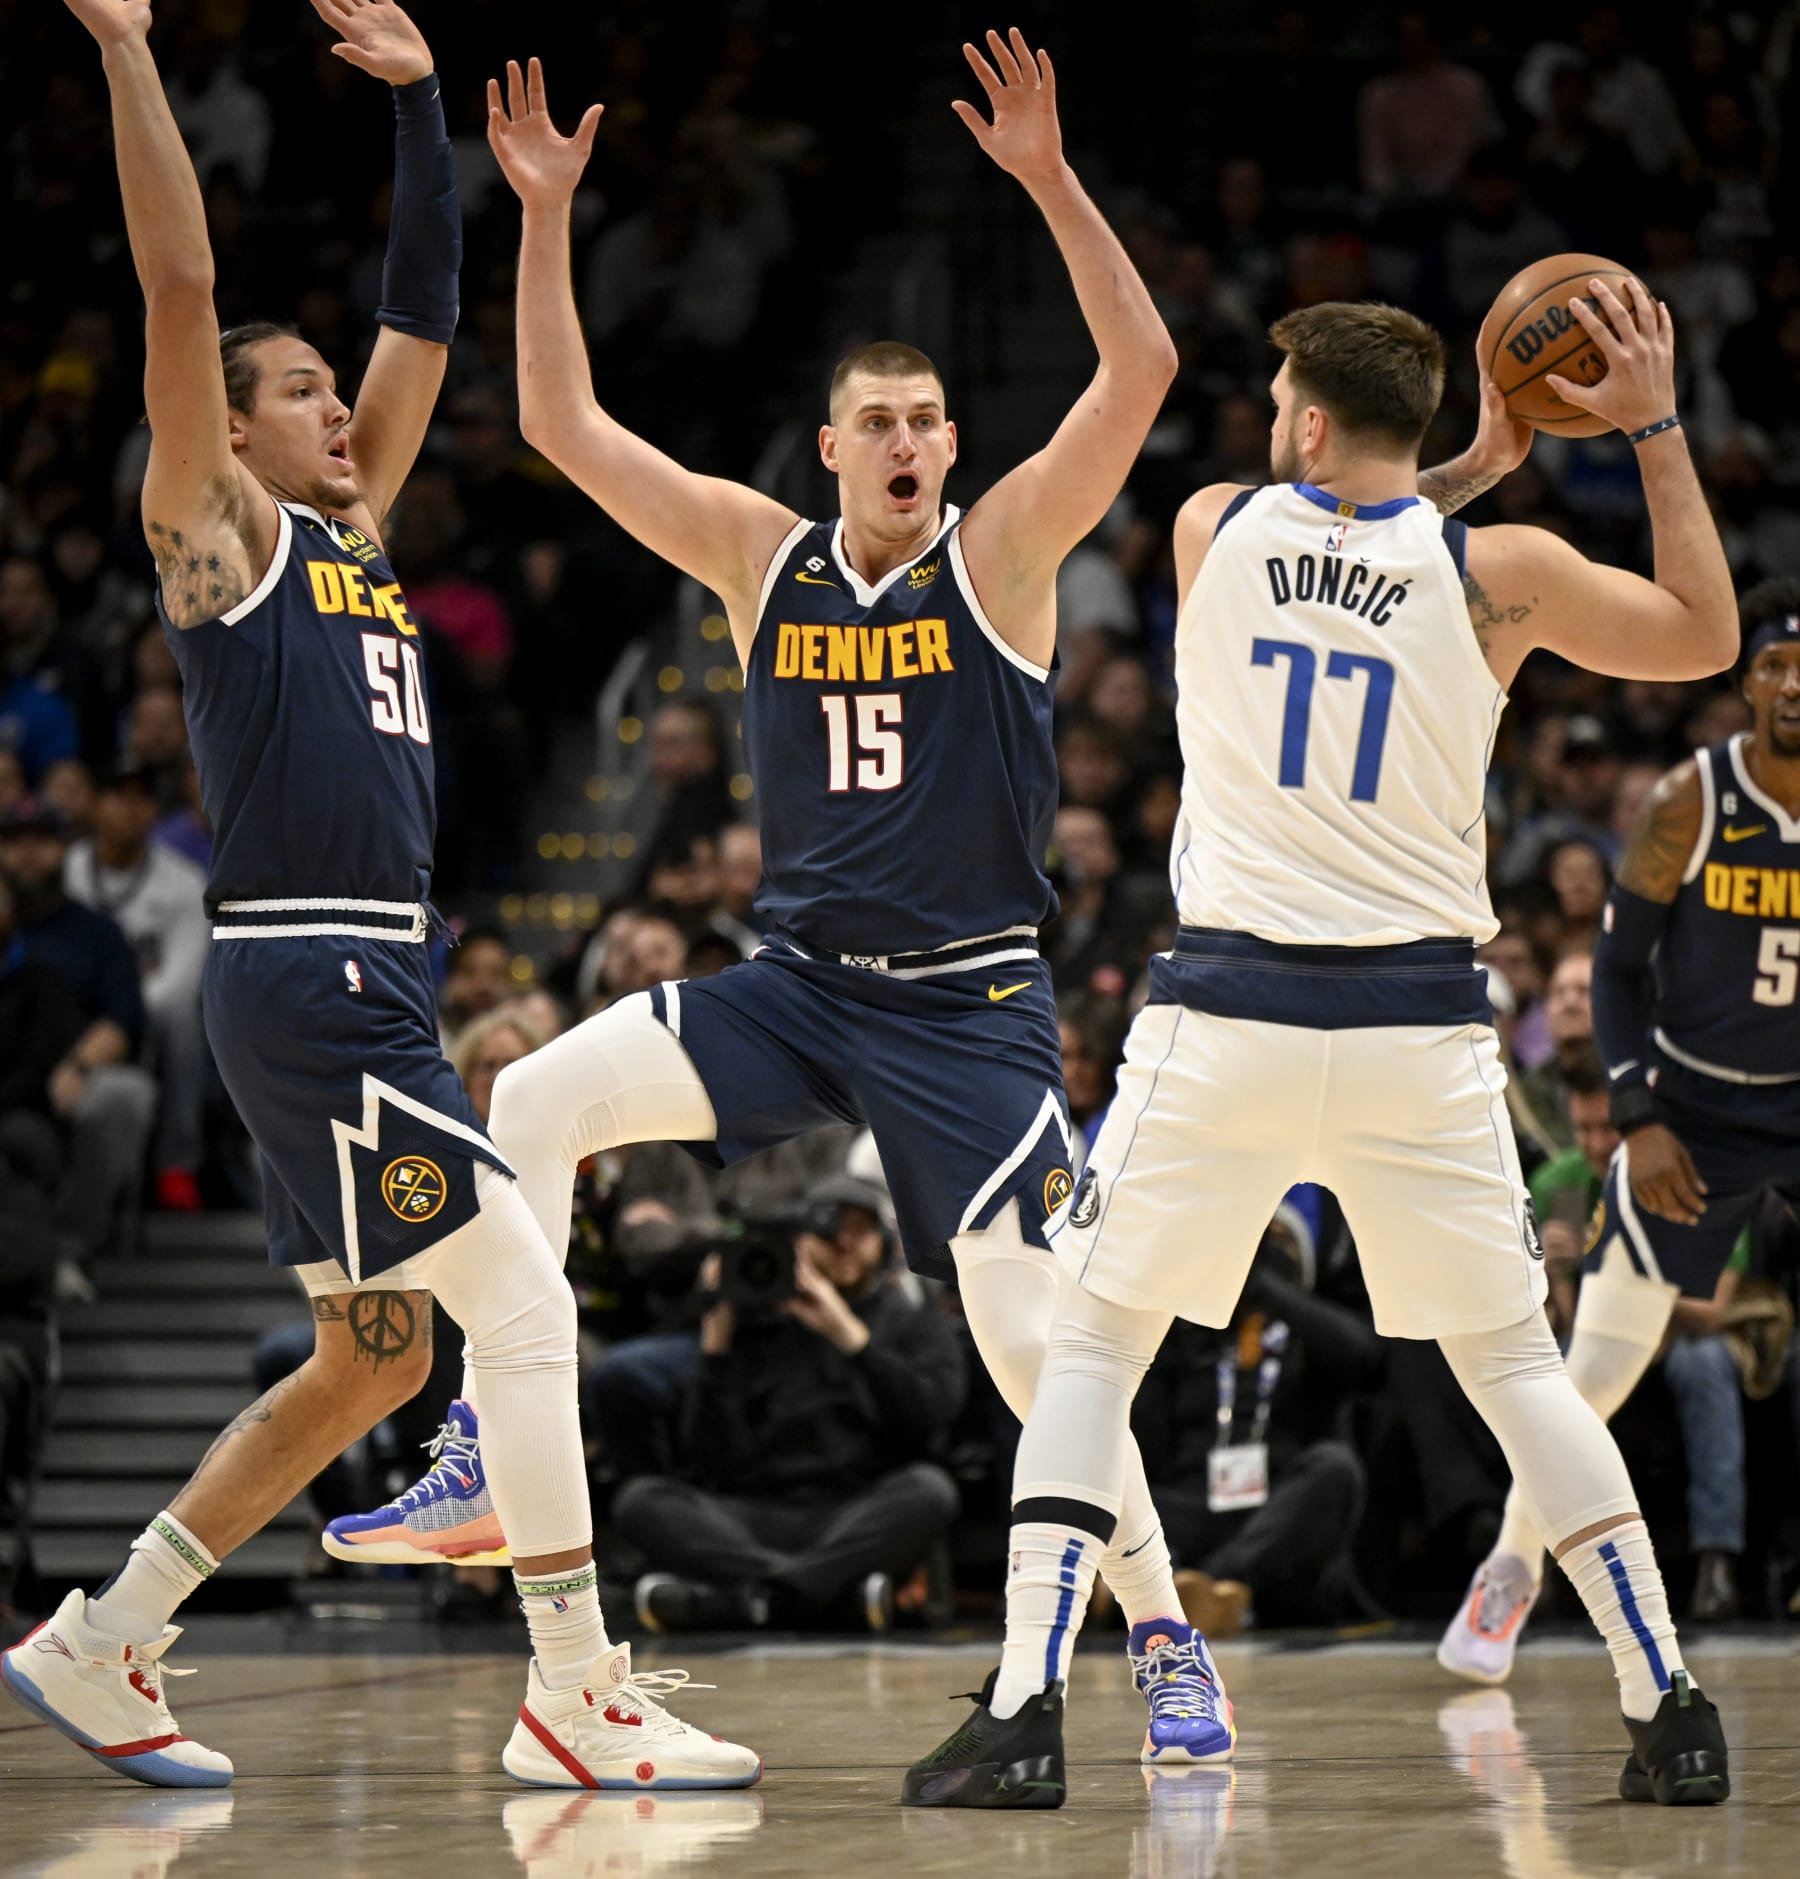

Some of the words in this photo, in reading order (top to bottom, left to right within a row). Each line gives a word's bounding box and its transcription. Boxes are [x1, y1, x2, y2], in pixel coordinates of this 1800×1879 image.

[805, 556, 826, 573] 6
[1265, 553, 1414, 628] DONČIĆ
[360, 631, 430, 746] 50
[773, 618, 955, 682] DENVER
[819, 692, 904, 792] 15
[1250, 636, 1396, 805] 77
[1722, 791, 1738, 816] 6
[1752, 924, 1800, 1008] 5
